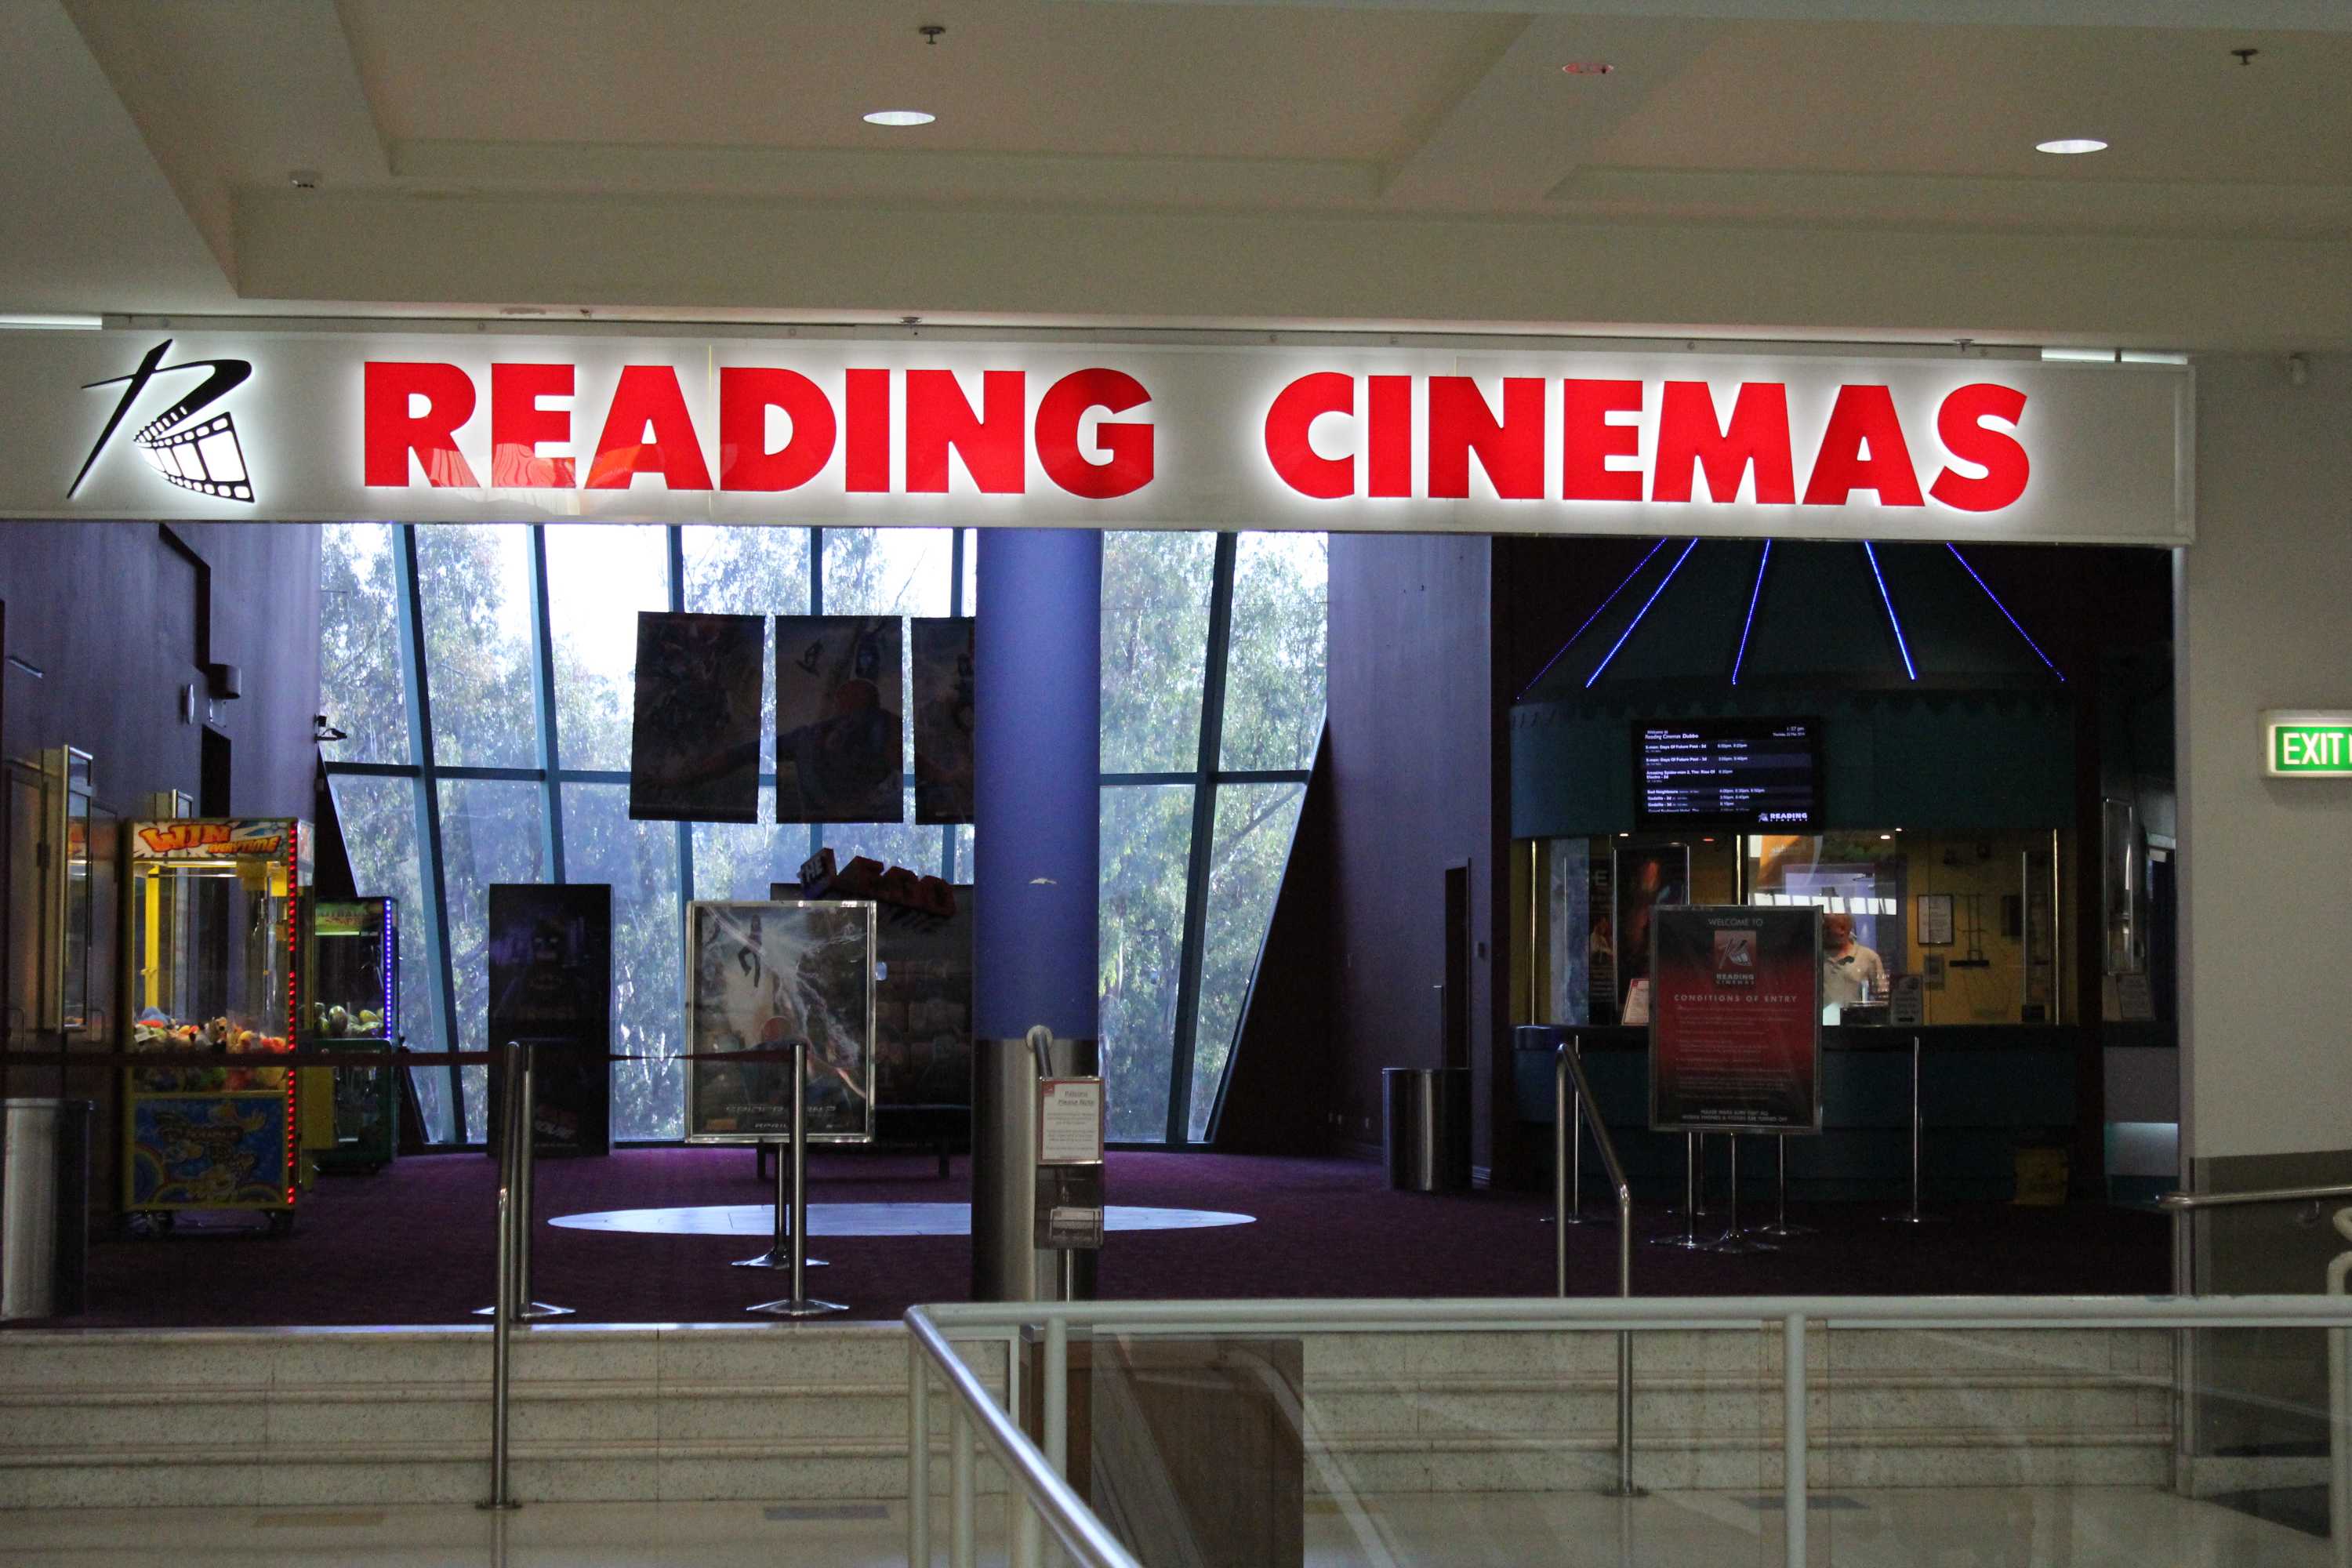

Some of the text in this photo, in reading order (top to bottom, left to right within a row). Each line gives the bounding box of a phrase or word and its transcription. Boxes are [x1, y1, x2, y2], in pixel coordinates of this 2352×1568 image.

[364, 361, 2030, 512] READING CINEMAS
[2283, 733, 2344, 765] EXIT
[138, 823, 232, 852] WIN
[208, 836, 281, 854] ANYTIME
[1707, 917, 1763, 927] WELCOME TO
[1674, 994, 1740, 1003] CONDITIONS
[1764, 995, 1798, 1004] ENTRY
